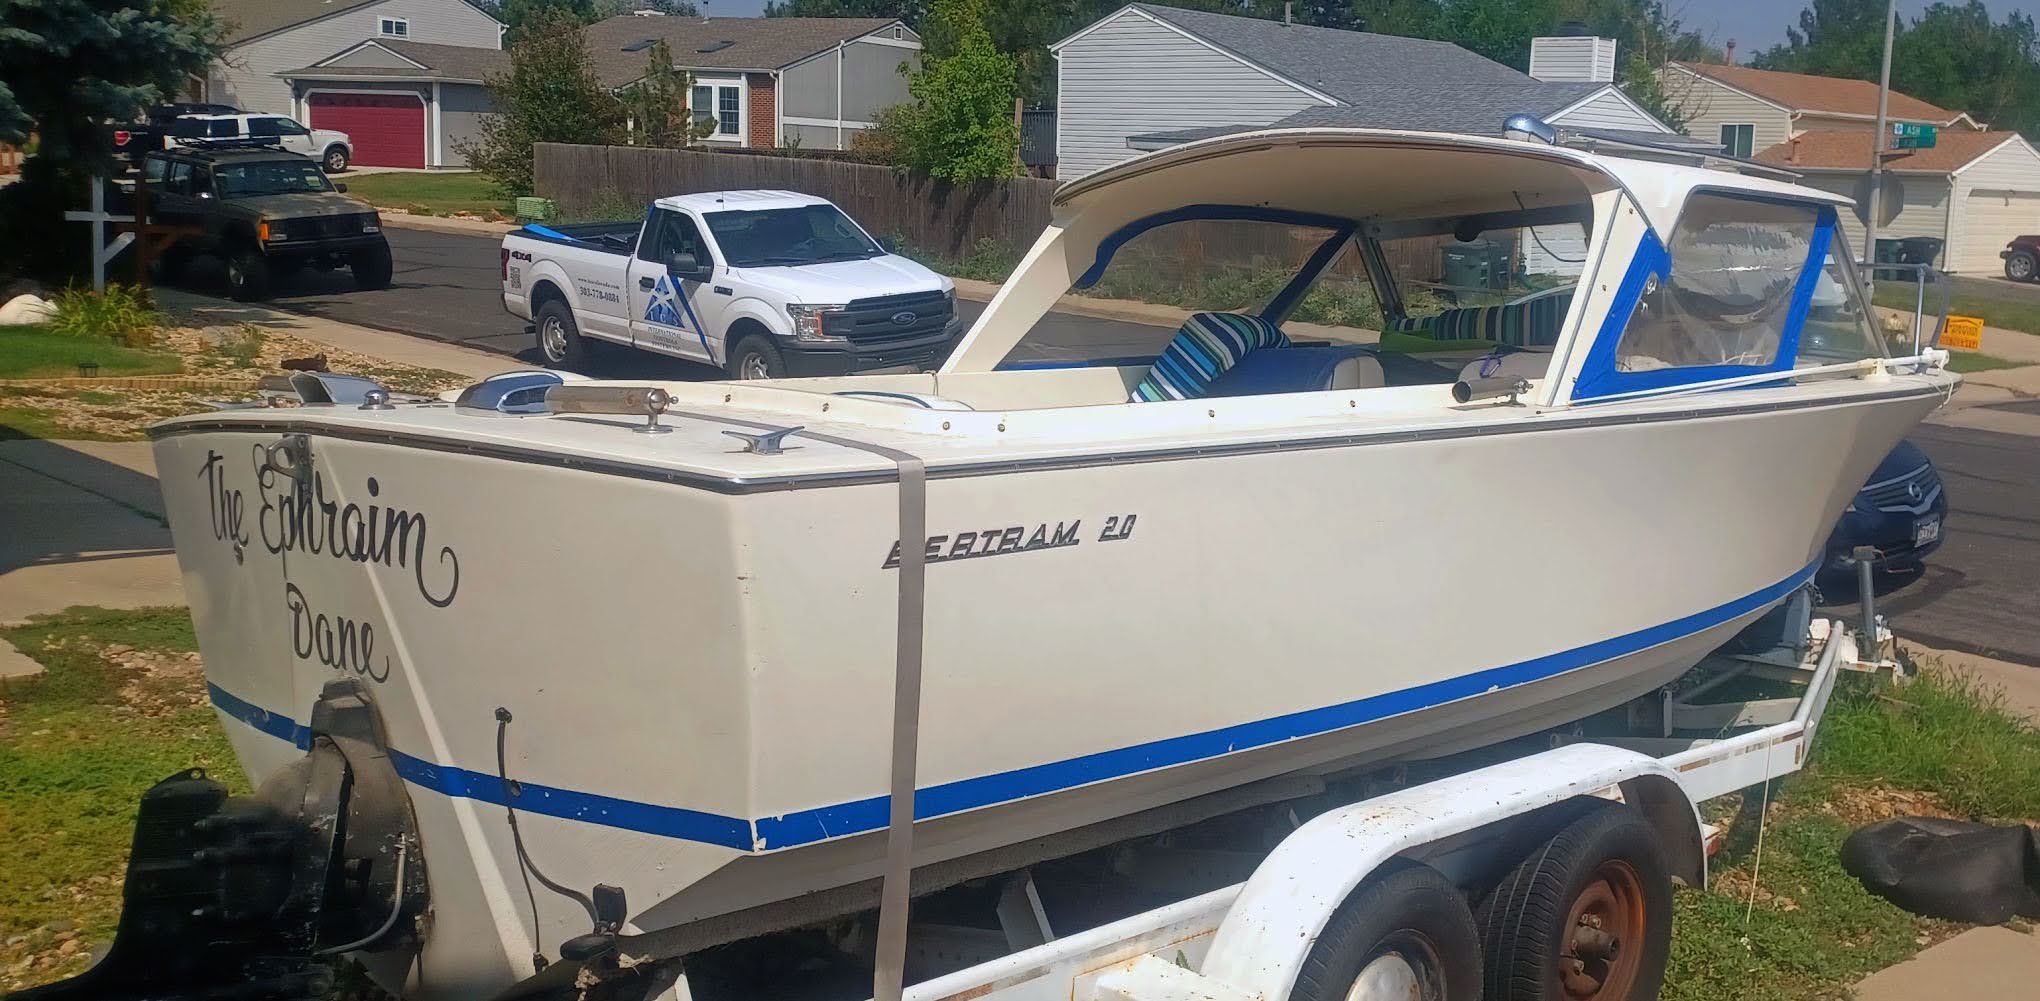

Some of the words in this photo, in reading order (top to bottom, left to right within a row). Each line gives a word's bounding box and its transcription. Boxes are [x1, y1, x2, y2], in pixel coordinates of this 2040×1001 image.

[252, 443, 460, 608] Ephraim
[1097, 513, 1138, 542] 20
[286, 582, 390, 684] Dane
